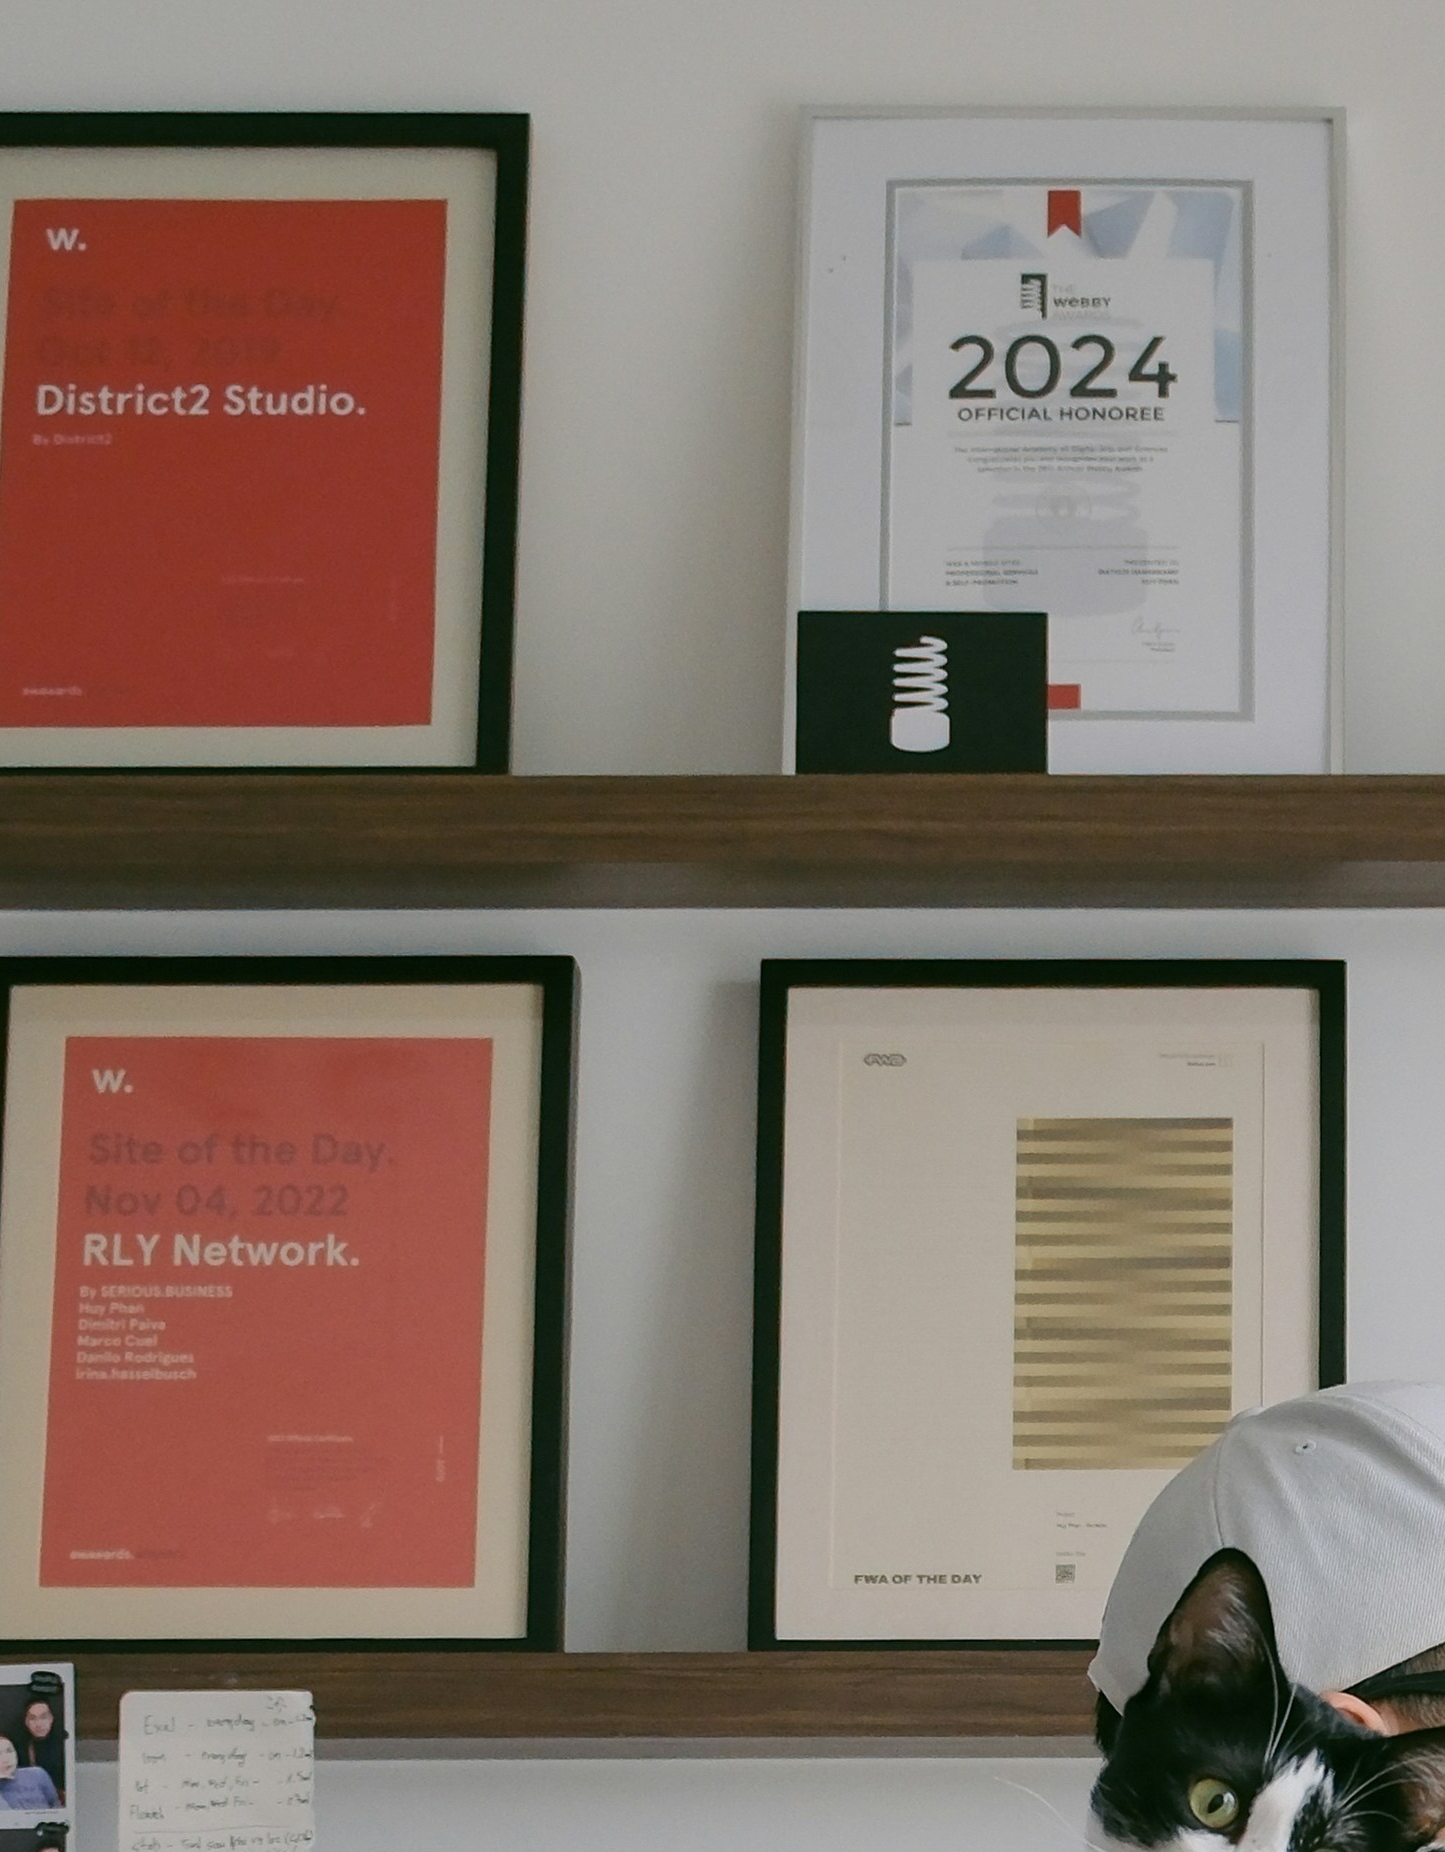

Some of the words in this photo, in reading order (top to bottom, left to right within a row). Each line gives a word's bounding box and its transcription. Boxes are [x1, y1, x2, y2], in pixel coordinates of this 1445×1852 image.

[948, 334, 1179, 399] 2024
[36, 384, 210, 416] District2
[222, 384, 367, 416] Studio.
[957, 407, 1052, 421] OFFICIAL
[1059, 407, 1166, 421] HONOREE
[89, 1132, 163, 1165] Site
[177, 1132, 220, 1165] of
[231, 1132, 298, 1165] the
[312, 1133, 395, 1173] Day.
[84, 1184, 161, 1217] Nov
[175, 1183, 239, 1221] 04,
[252, 1184, 349, 1217] 2022
[83, 1233, 161, 1267] RLY
[172, 1233, 360, 1267] Network.
[79, 1285, 97, 1300] By
[854, 1574, 889, 1585] FWA
[892, 1574, 913, 1585] OF
[916, 1574, 948, 1585] THE
[951, 1574, 983, 1585] DAY
